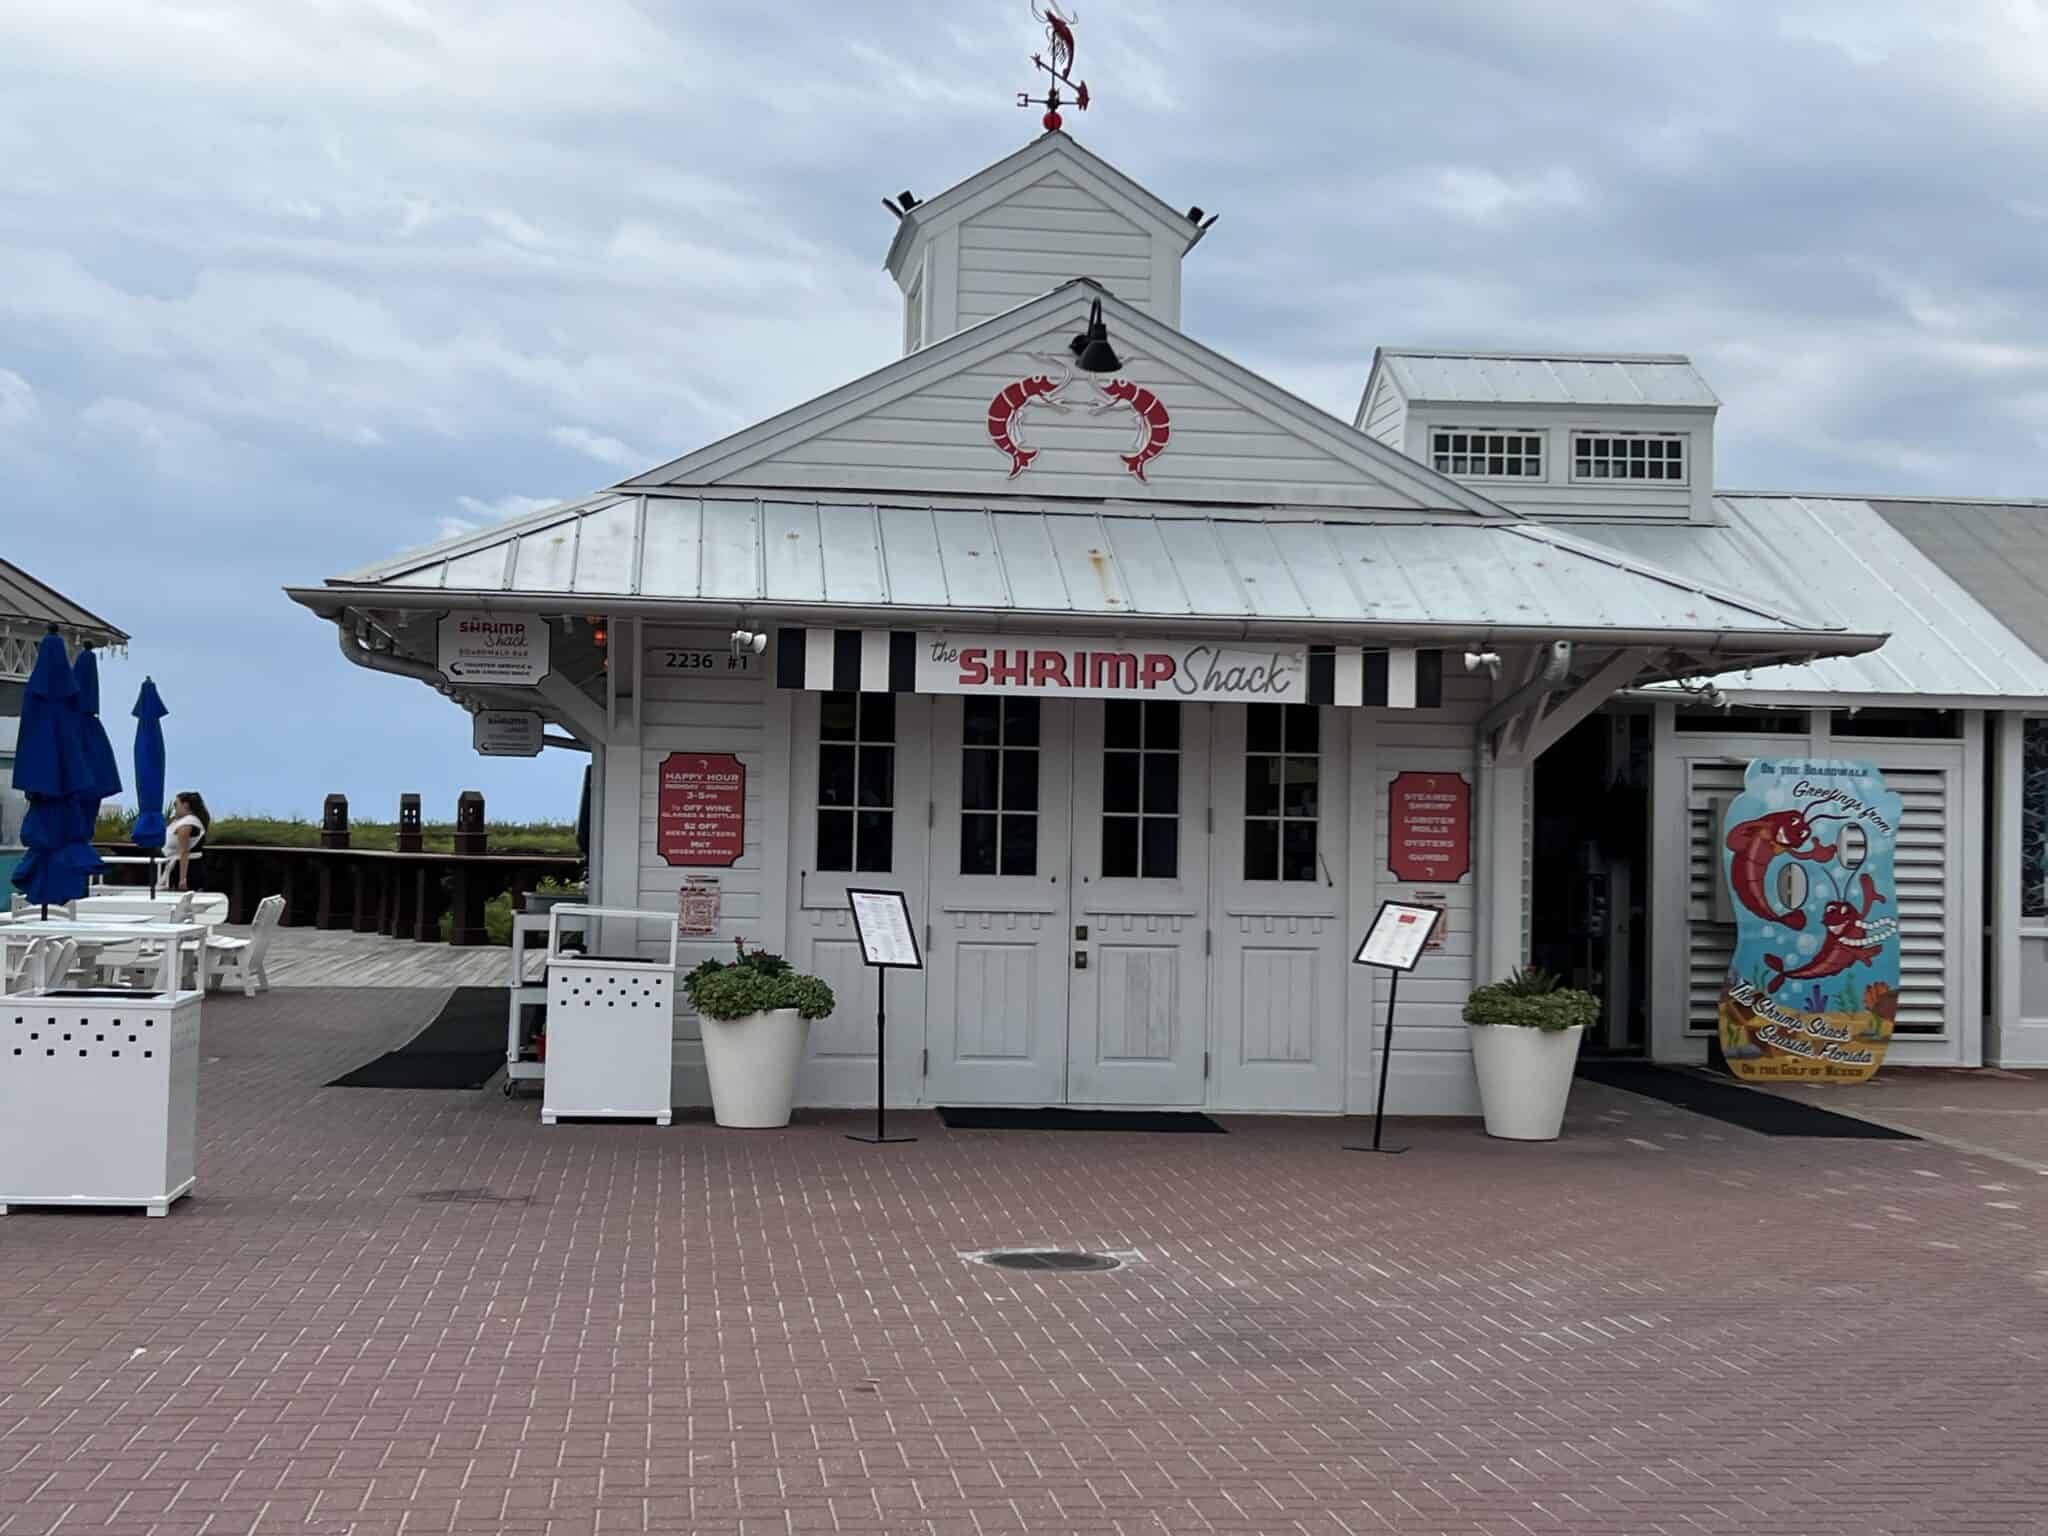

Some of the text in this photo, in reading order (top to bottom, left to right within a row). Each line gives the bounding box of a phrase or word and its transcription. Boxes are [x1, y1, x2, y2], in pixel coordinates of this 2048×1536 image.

[458, 621, 526, 634] SHRIMP
[483, 629, 529, 648] Shack
[665, 652, 748, 671] 2236 #1
[928, 639, 1292, 695] the SHRIMP Shack
[664, 772, 740, 782] HAPPY HOUR
[1792, 780, 1863, 812] Greetings
[682, 804, 704, 812] OFF
[705, 804, 733, 813] WINE
[698, 823, 719, 831] OFF
[1858, 806, 1894, 834] from
[1403, 839, 1455, 849] OYSTERS
[1729, 980, 1850, 1042] The Shrimp Shack
[1817, 1041, 1874, 1065] Florida
